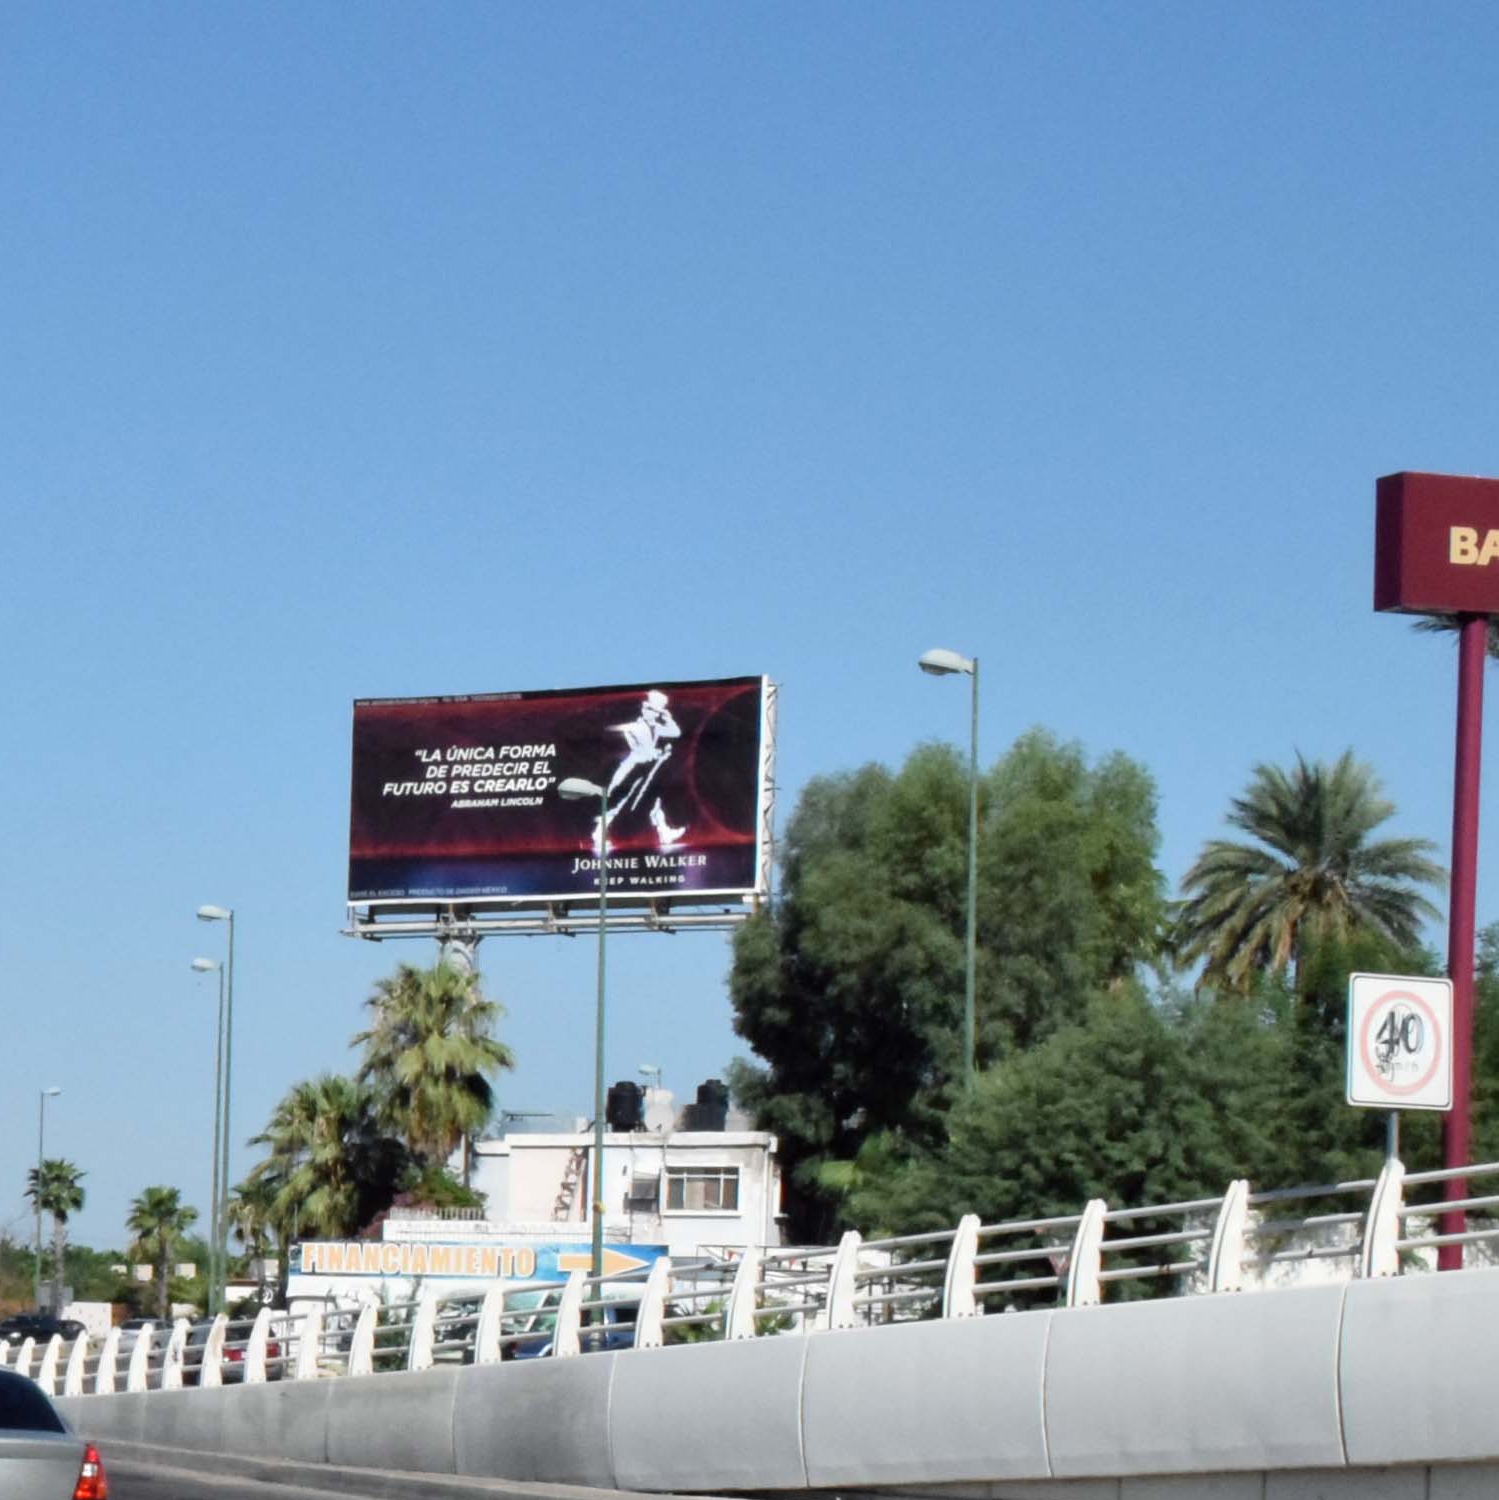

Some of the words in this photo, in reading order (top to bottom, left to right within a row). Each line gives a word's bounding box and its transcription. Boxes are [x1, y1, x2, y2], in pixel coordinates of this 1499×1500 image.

[446, 745, 495, 761] ÚNICA
[499, 744, 556, 759] FORMA
[426, 765, 448, 779] DE
[451, 763, 529, 777] PREDECIR
[532, 761, 552, 775] EL
[382, 781, 447, 796] FUTURO
[450, 780, 469, 794] ES
[451, 798, 498, 808] ABRAHAM
[500, 797, 544, 807] LINCOLN
[593, 877, 624, 885] KEP
[629, 875, 685, 885] WALKING
[301, 1242, 537, 1277] FINANCIAMIENTO
